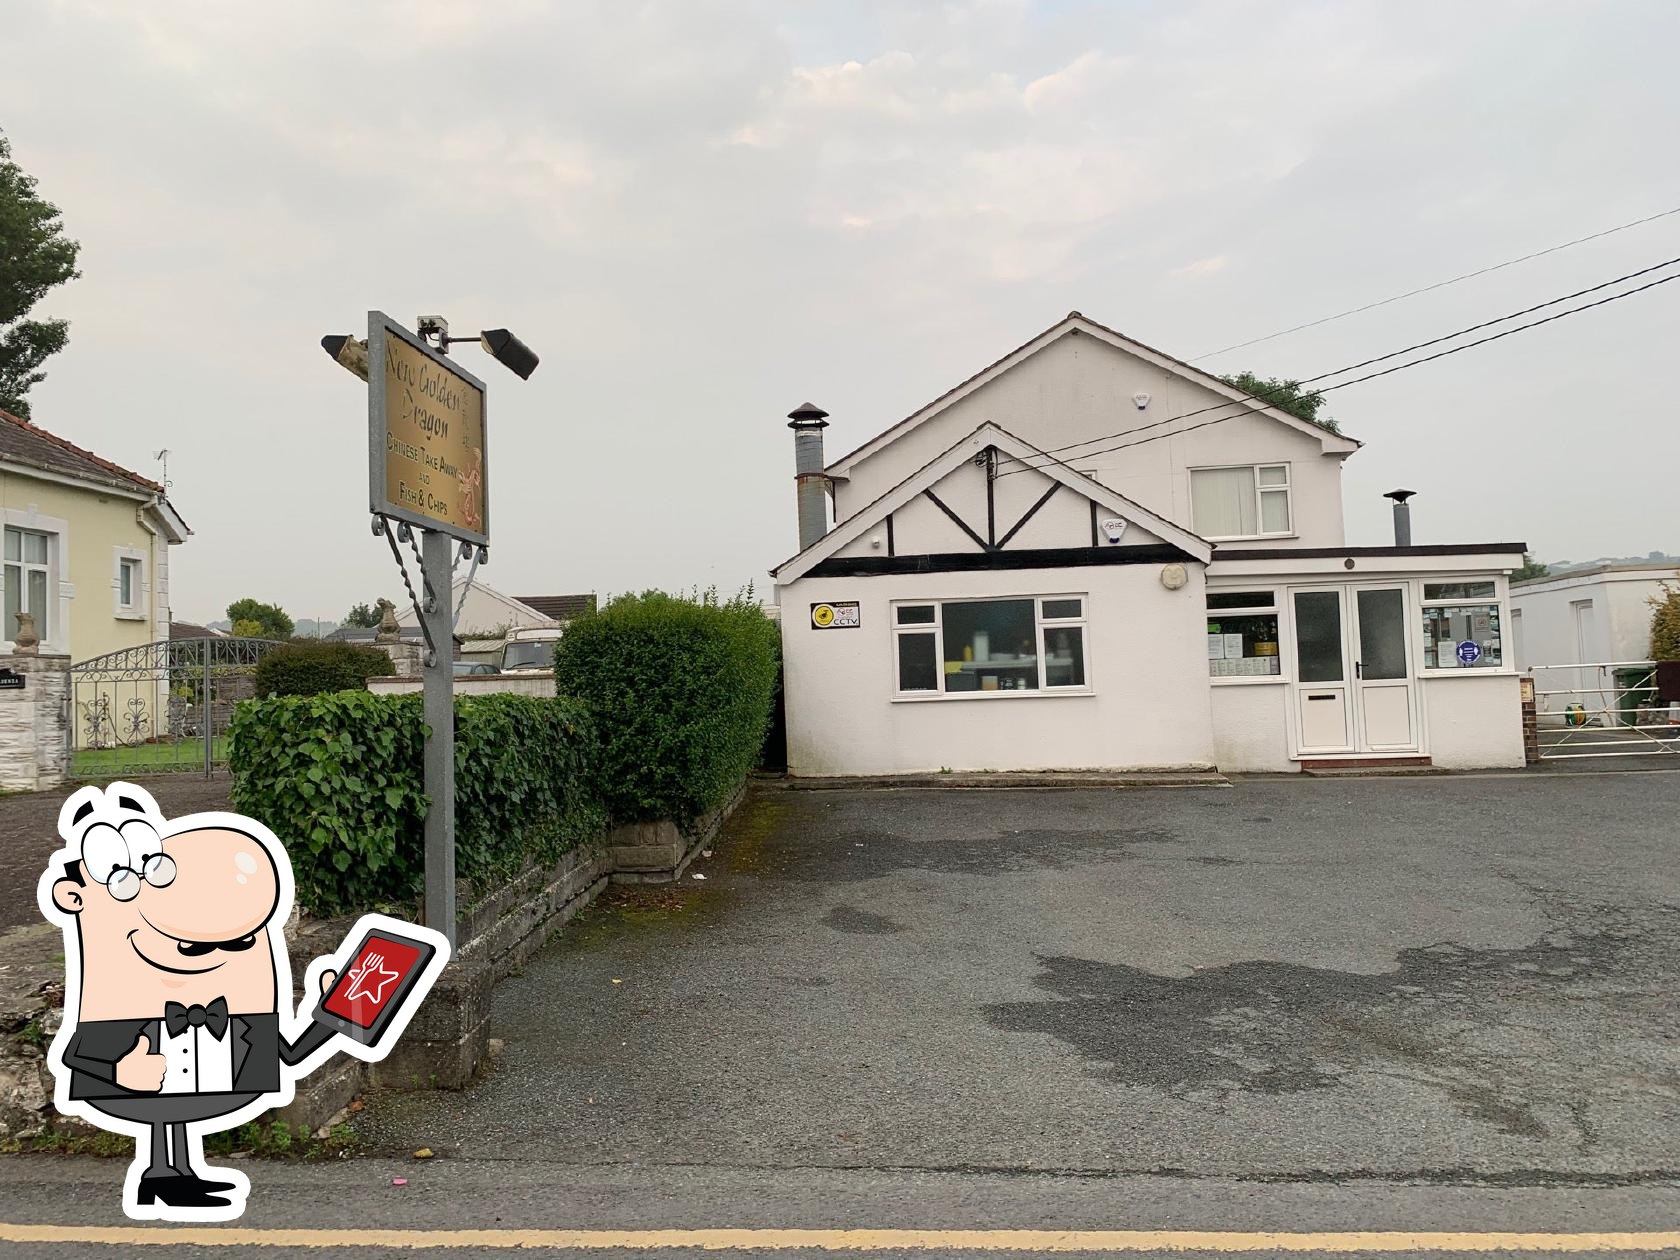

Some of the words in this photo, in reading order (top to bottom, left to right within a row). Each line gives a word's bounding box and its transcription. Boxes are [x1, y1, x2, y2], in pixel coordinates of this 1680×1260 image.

[385, 338, 415, 387] New
[419, 364, 460, 411] Golden
[401, 388, 448, 440] Dragon
[386, 431, 419, 462] CHINESE
[420, 446, 438, 471] TAKE
[439, 456, 458, 479] AWAY
[419, 472, 430, 485] AND
[399, 481, 417, 504] FISH
[418, 489, 425, 507] &
[427, 493, 448, 515] CHIPS
